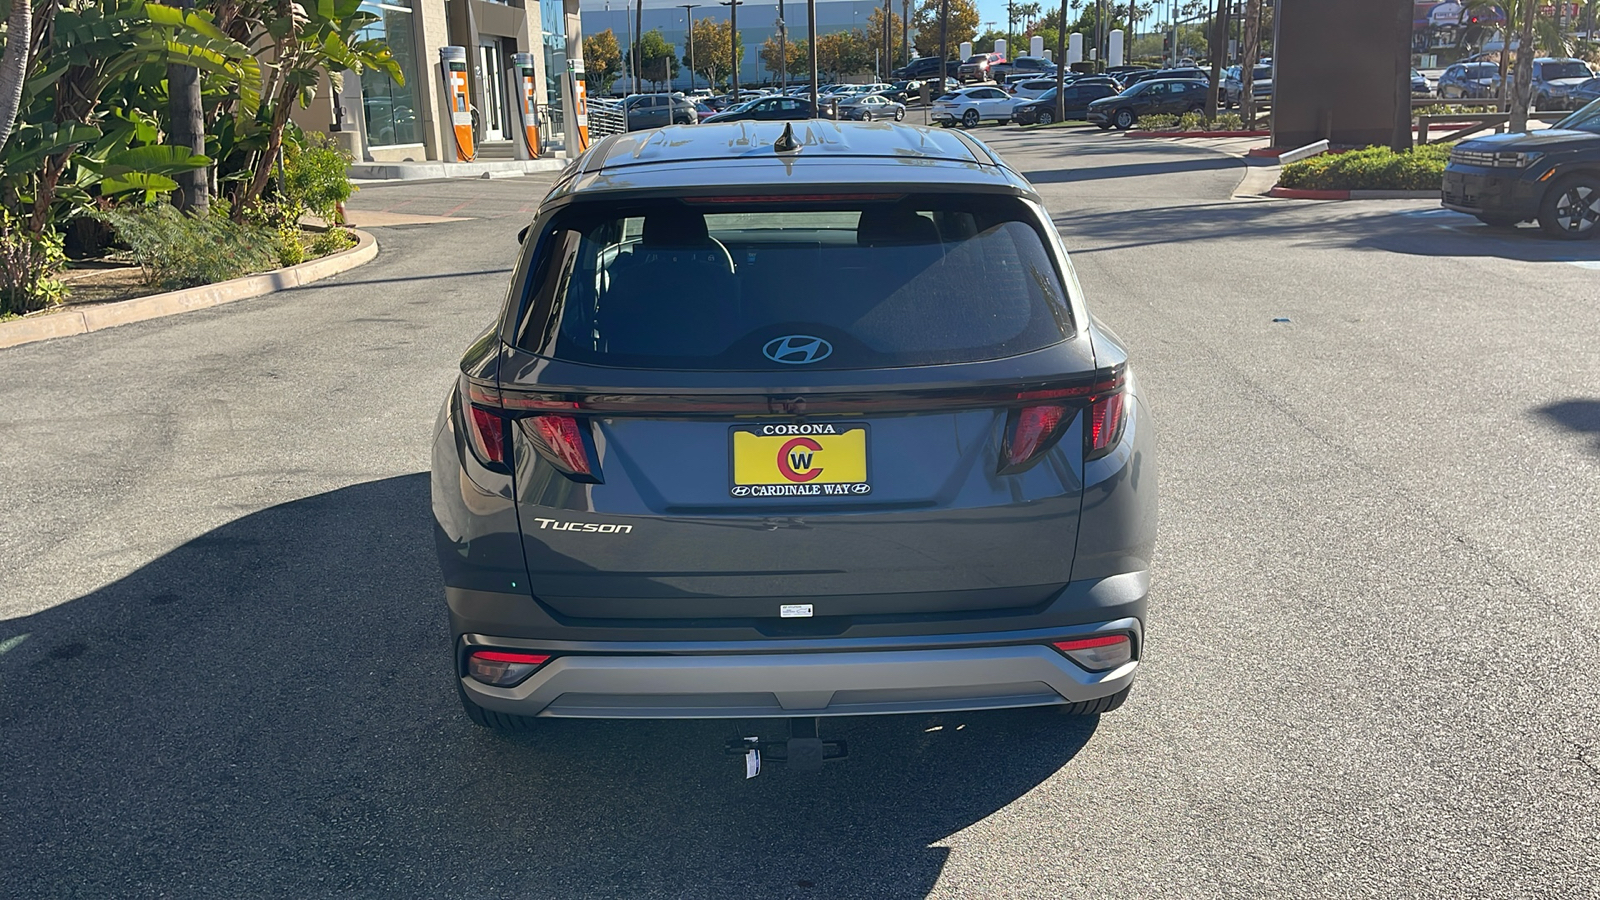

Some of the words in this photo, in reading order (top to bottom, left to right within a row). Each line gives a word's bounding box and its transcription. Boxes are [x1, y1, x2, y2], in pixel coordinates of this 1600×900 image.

[763, 424, 836, 435] CORONA
[751, 484, 821, 496] CARDINALE
[823, 484, 851, 495] WAY
